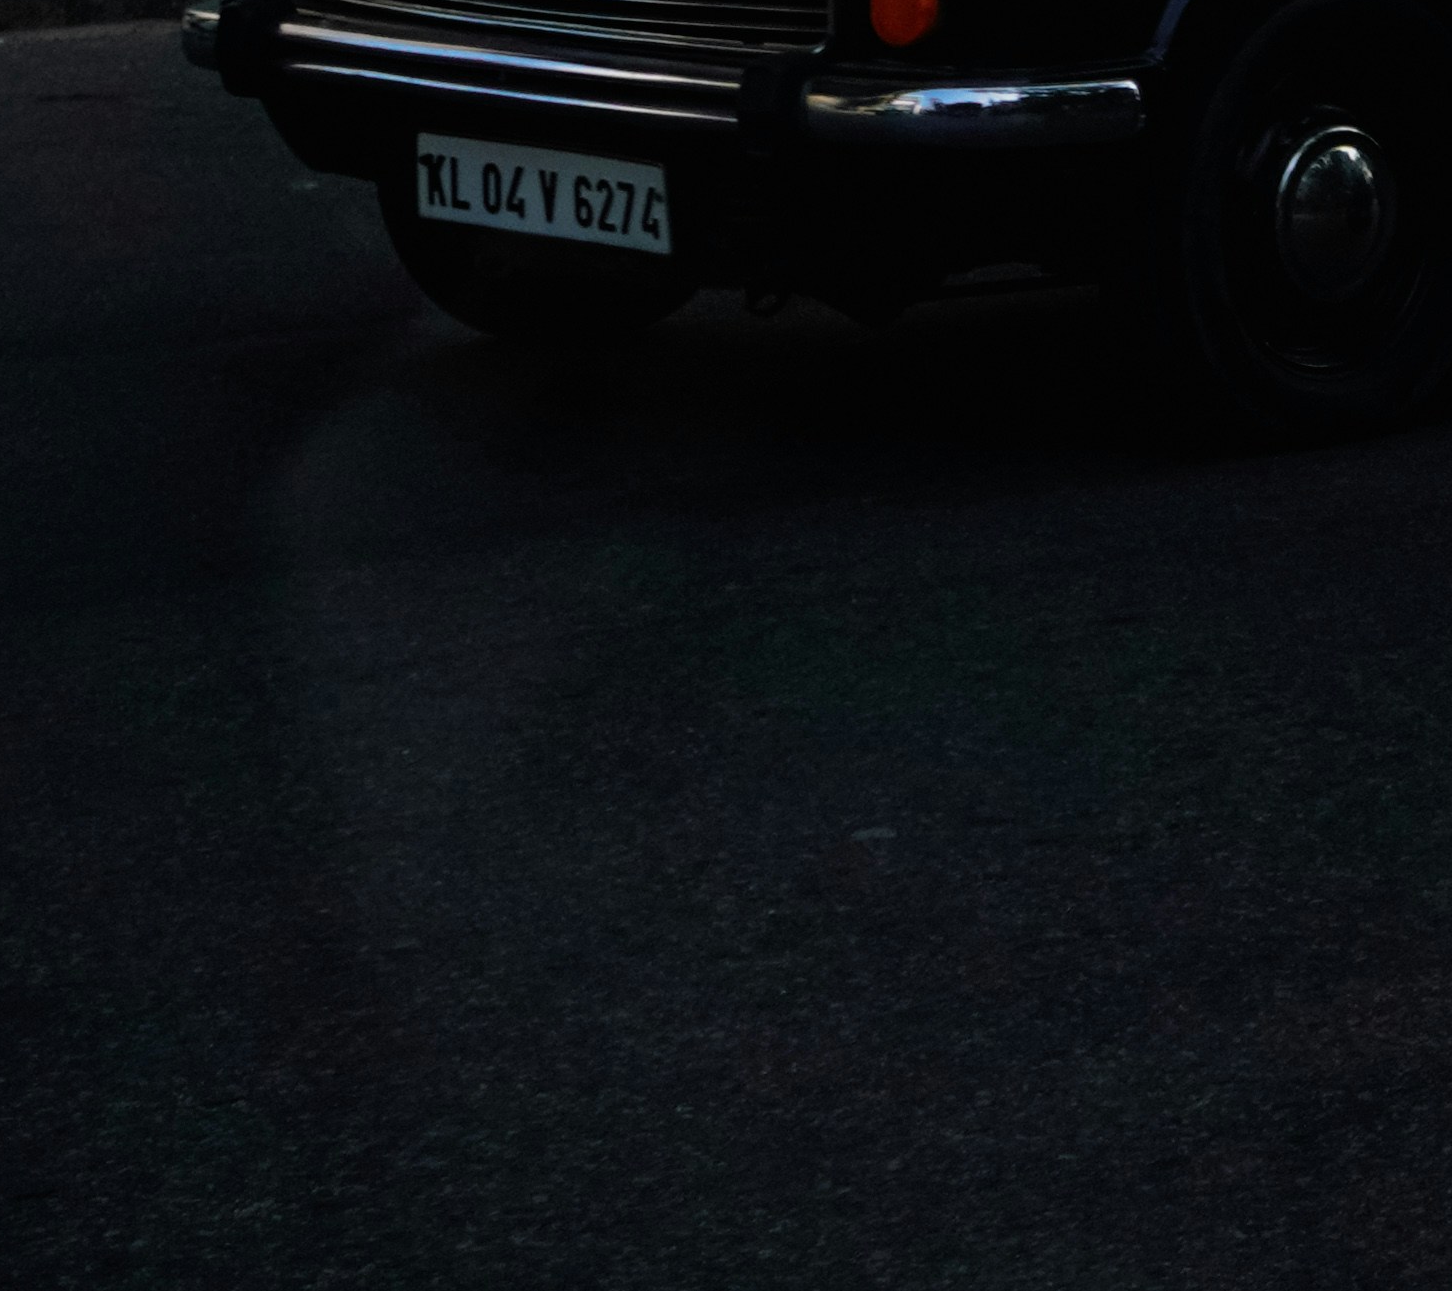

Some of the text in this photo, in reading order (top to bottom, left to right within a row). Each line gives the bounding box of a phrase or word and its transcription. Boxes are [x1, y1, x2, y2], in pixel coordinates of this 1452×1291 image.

[419, 151, 666, 240] KL 04 V 6274
